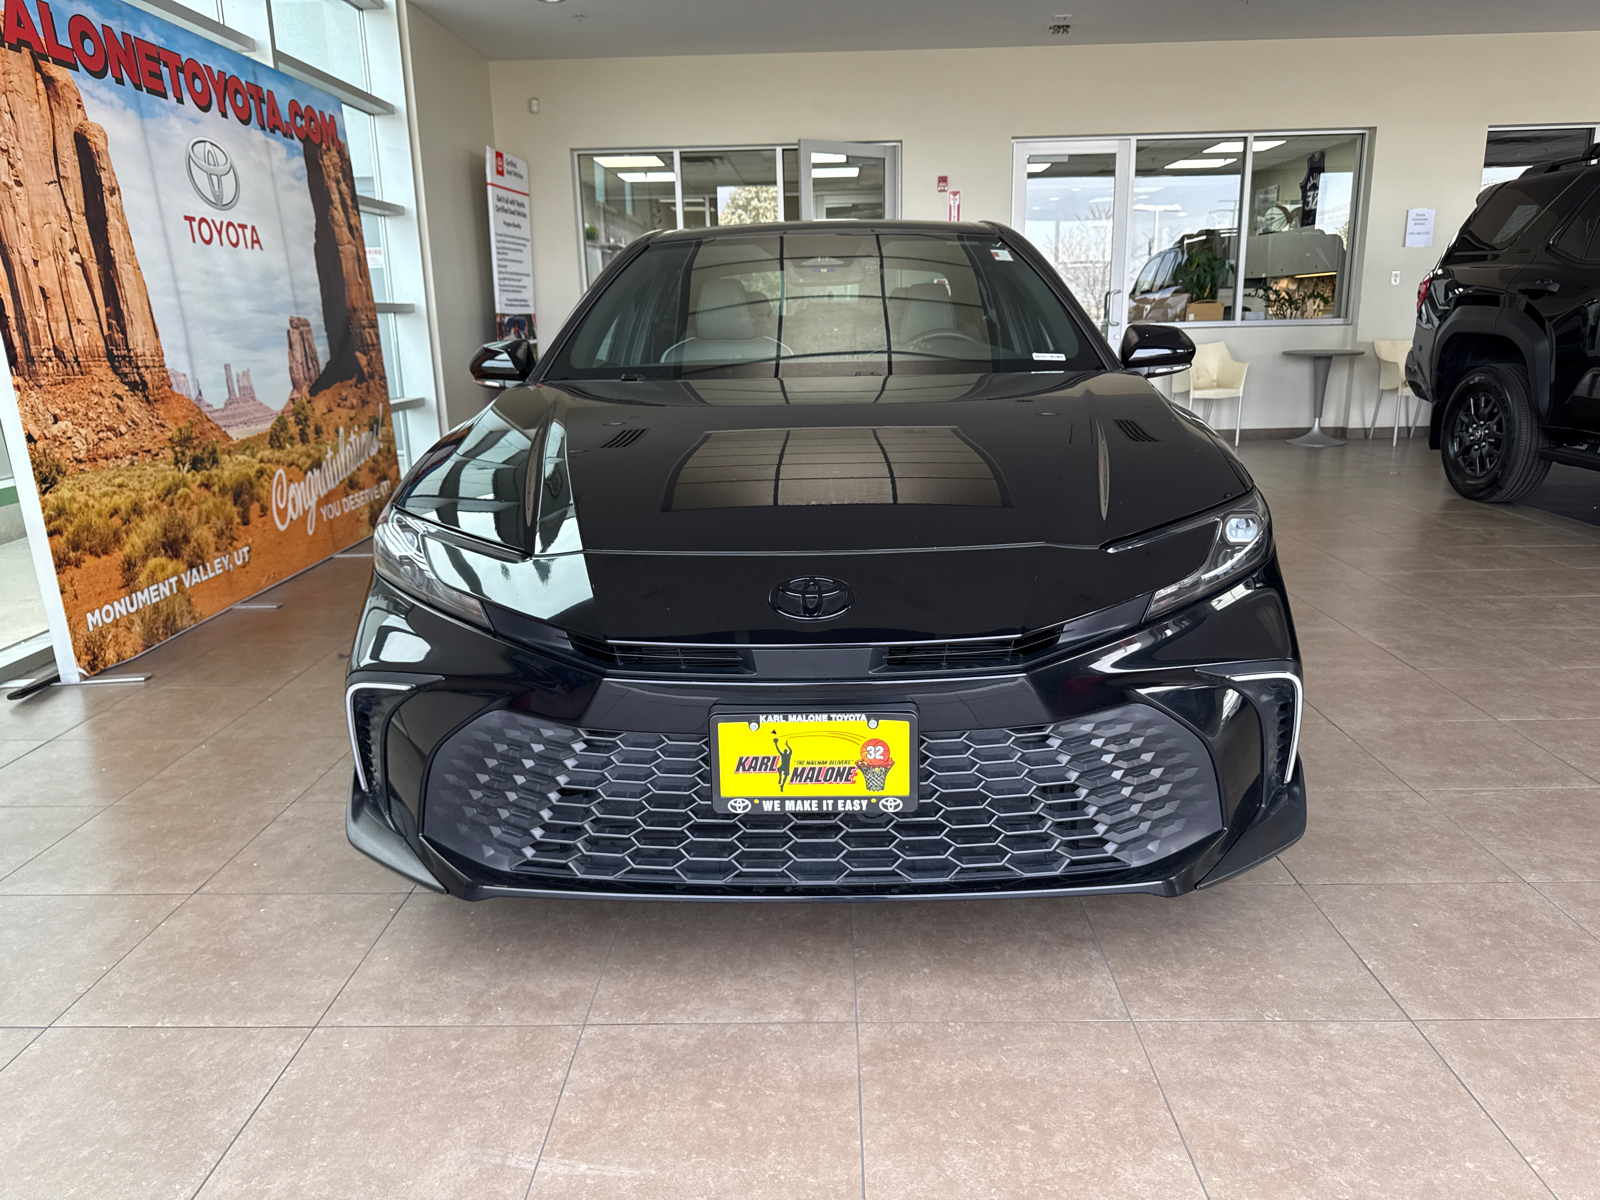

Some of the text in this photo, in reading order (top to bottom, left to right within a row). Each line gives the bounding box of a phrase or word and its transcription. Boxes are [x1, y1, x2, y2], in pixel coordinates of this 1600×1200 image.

[0, 0, 341, 150] ALONETOYOTA.COM
[184, 215, 263, 251] TOYOTA
[272, 401, 384, 536] Congratulations!
[320, 500, 342, 522] YOU
[342, 483, 381, 513] DESERVE
[86, 546, 250, 632] MONUMENT VALLEY, UT
[759, 714, 867, 723] KARL MALONE TOYOTA
[735, 755, 780, 773] KARL
[866, 745, 884, 759] 32
[788, 766, 857, 785] MALONE
[762, 799, 868, 811] WE MAKE IT EASY
